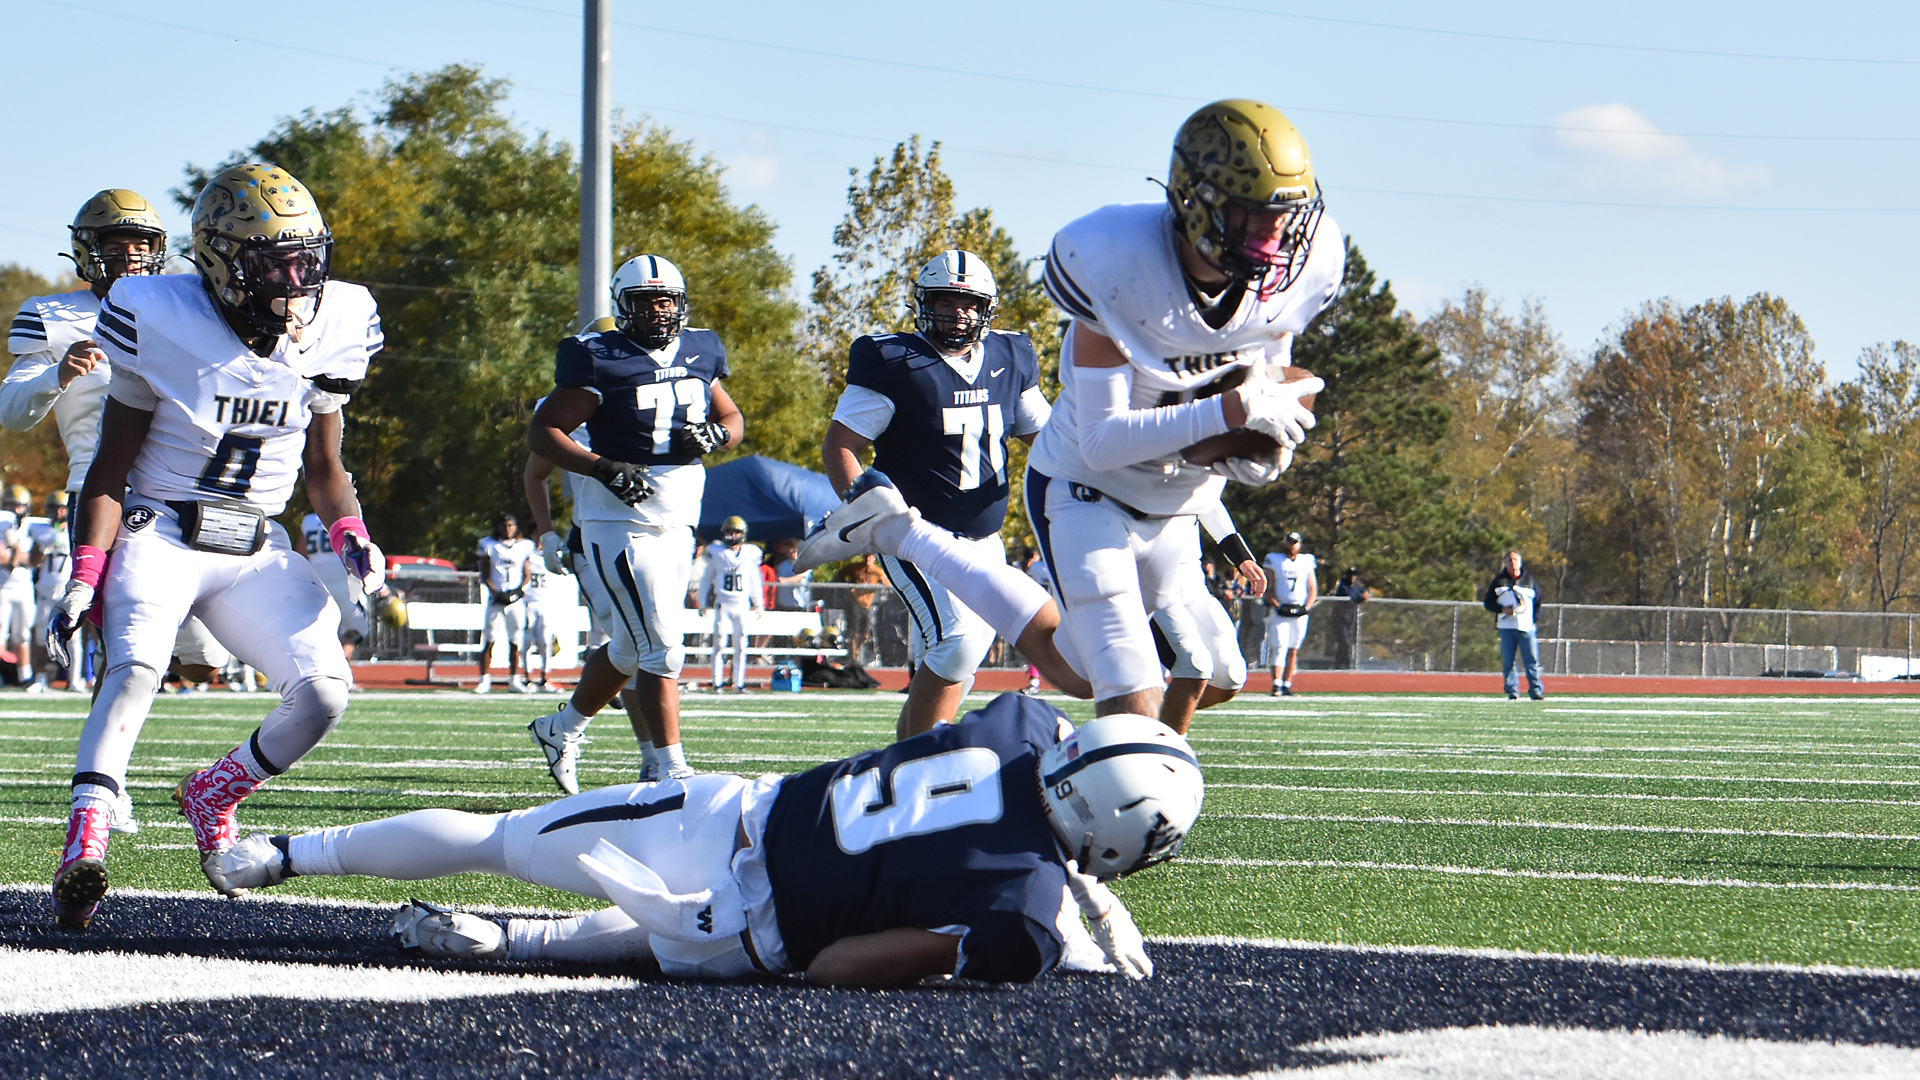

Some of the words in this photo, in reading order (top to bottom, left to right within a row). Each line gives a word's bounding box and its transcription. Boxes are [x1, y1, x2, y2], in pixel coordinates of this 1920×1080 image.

[653, 366, 688, 382] TITANS
[213, 393, 290, 427] THIEL
[953, 388, 990, 405] TITANS
[942, 404, 1006, 491] 71
[194, 429, 267, 501] 0
[829, 747, 1005, 856] 9
[1055, 780, 1074, 800] 9
